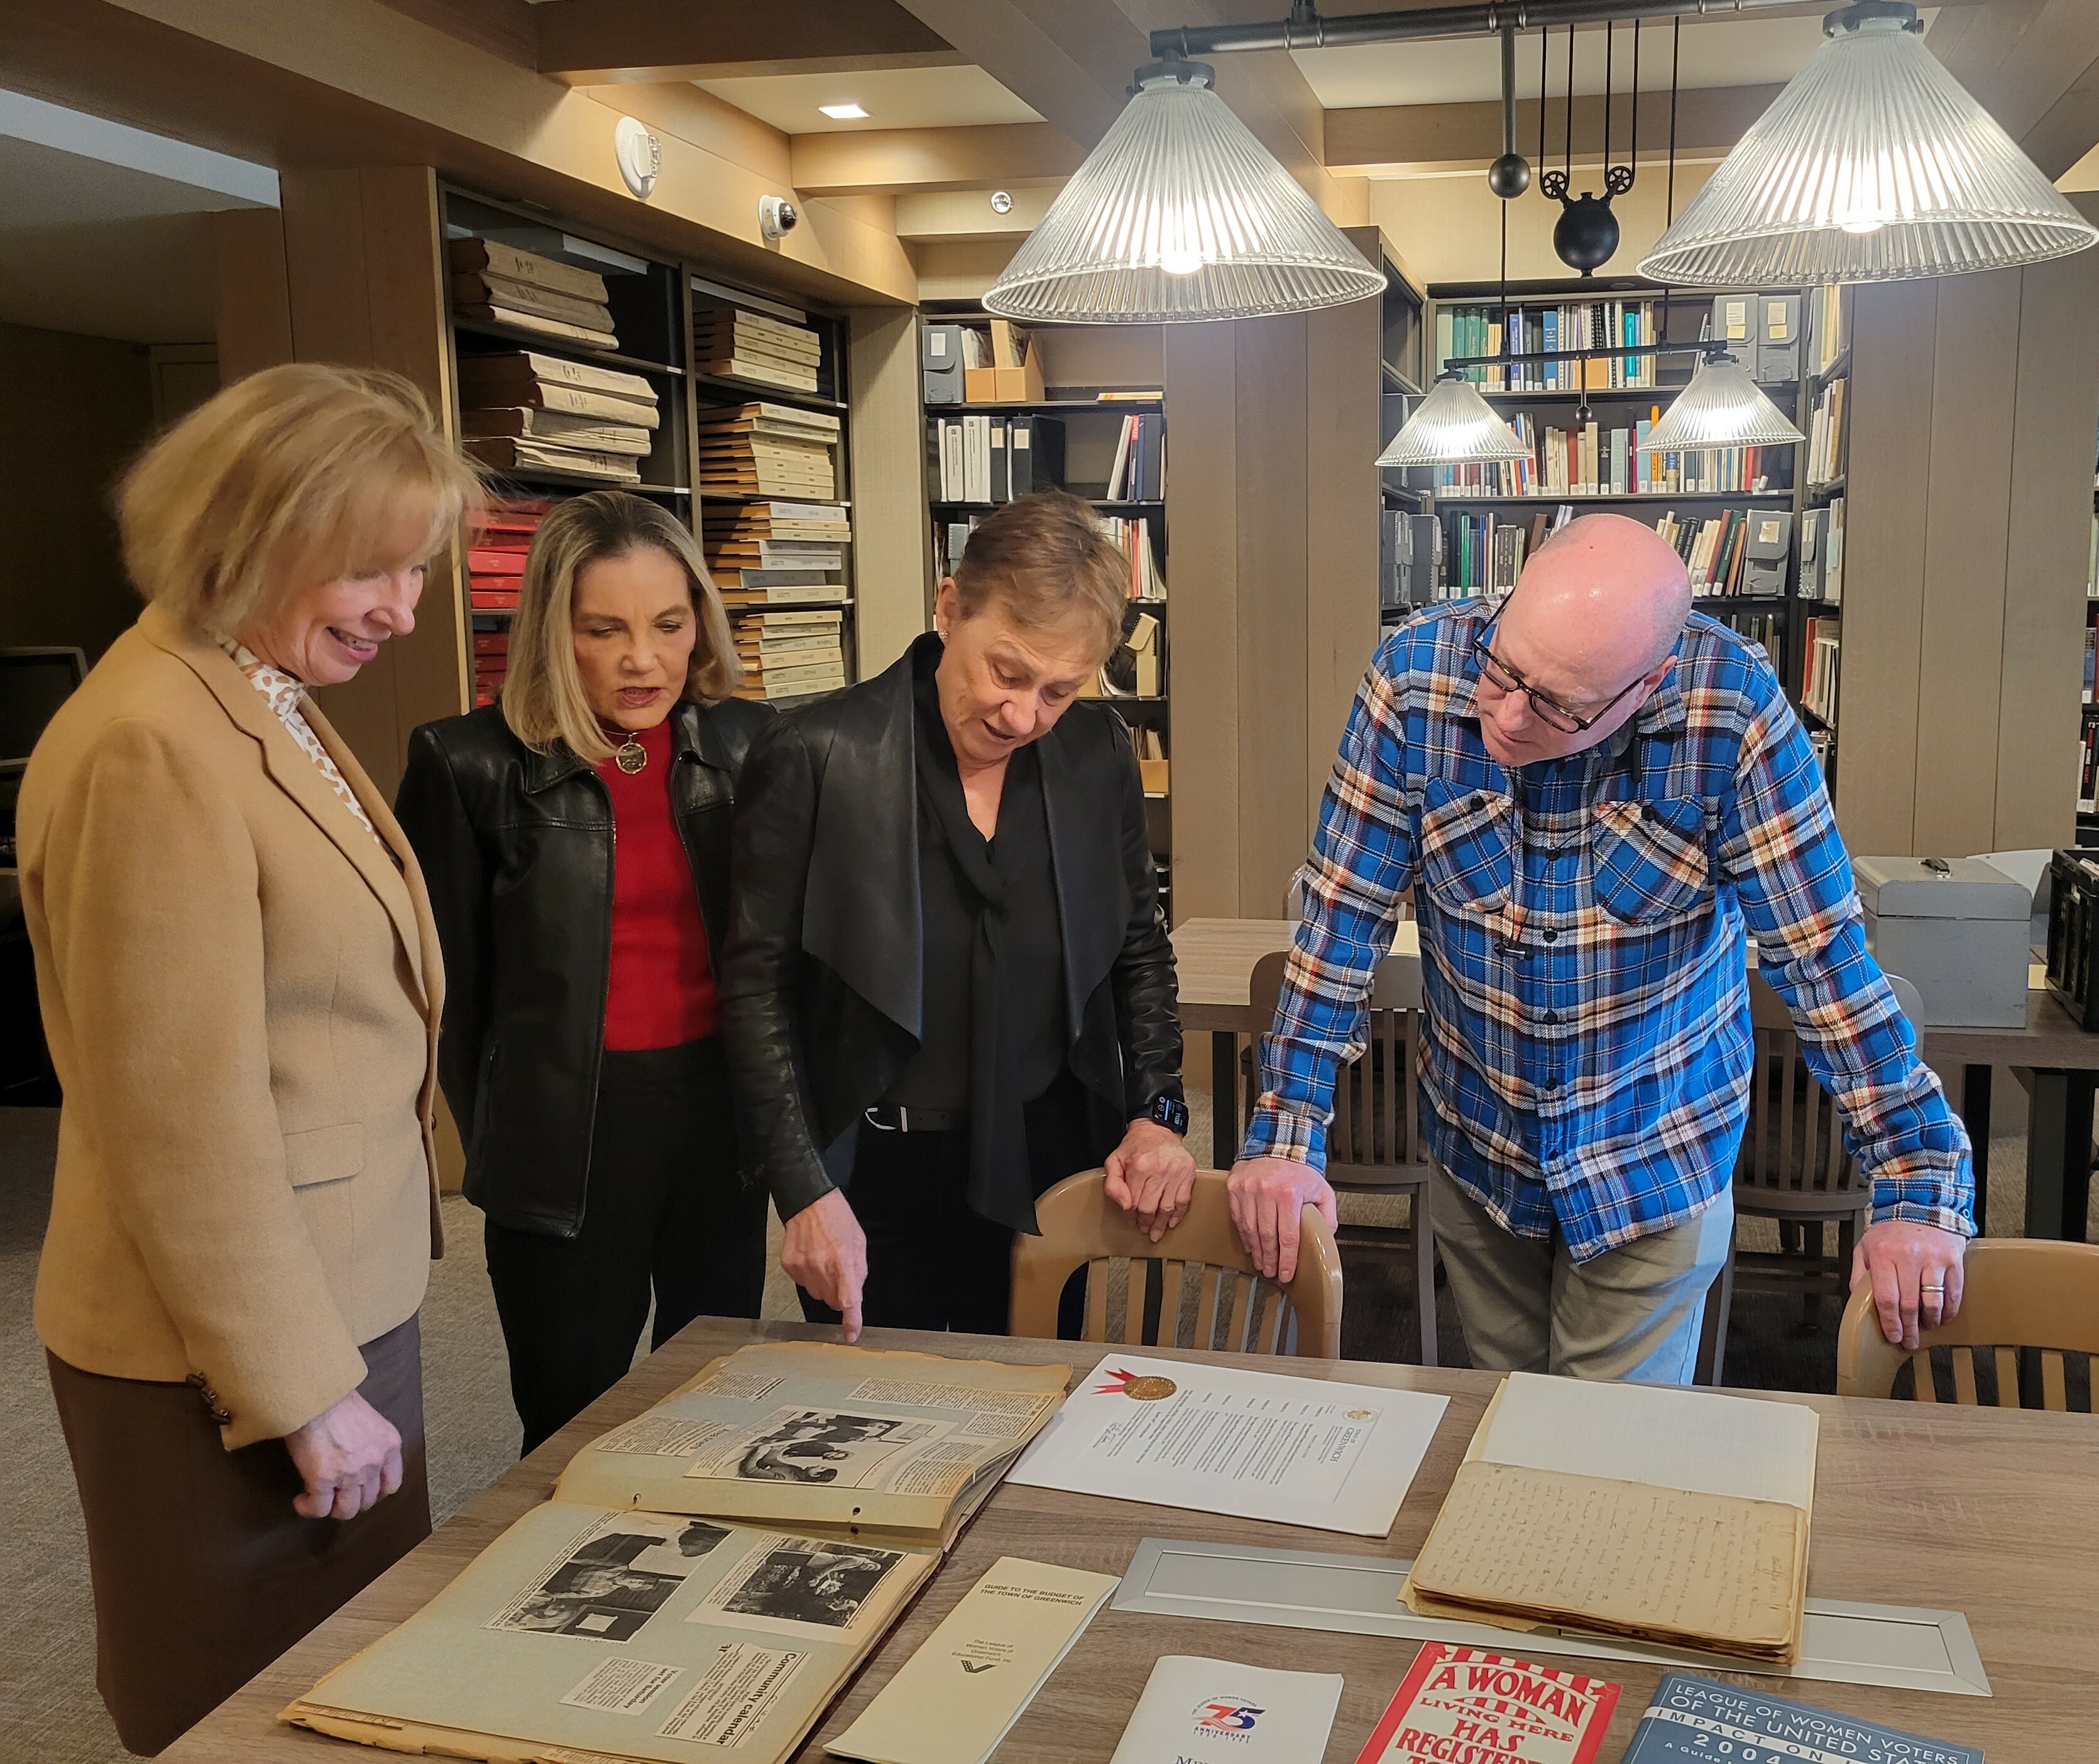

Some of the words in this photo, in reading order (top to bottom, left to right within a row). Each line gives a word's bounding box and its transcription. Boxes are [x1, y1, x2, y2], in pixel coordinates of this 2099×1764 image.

[1330, 1427, 1354, 1462] GREENWICH
[1034, 1596, 1082, 1606] GREENWICH
[657, 1668, 668, 1676] set
[660, 1670, 679, 1684] Voter
[746, 1652, 797, 1703] Community
[623, 1684, 652, 1709] Saturday
[638, 1684, 661, 1704] session
[1424, 1666, 1459, 1691] A
[1467, 1666, 1588, 1728] WOMAN
[716, 1704, 753, 1745] calendar
[1194, 1726, 1251, 1739] ANNIVERSARY
[1200, 1704, 1266, 1729] 75
[1419, 1697, 1500, 1723] LIVING
[1508, 1719, 1574, 1742] HERE
[1670, 1696, 1704, 1711] OF
[1714, 1705, 1757, 1728] THE
[1766, 1721, 1857, 1753] UNITED
[1675, 1684, 1749, 1711] LEAGUE
[1755, 1706, 1783, 1719] OF
[1790, 1713, 1872, 1744] WOMEN
[1881, 1738, 1958, 1764] VOTERS
[1450, 1717, 1525, 1752] HAS
[1657, 1709, 1766, 1745] IMPACT
[1786, 1745, 1823, 1761] ON
[1692, 1733, 1781, 1764] 2004
[1680, 1745, 1721, 1763] Guide
